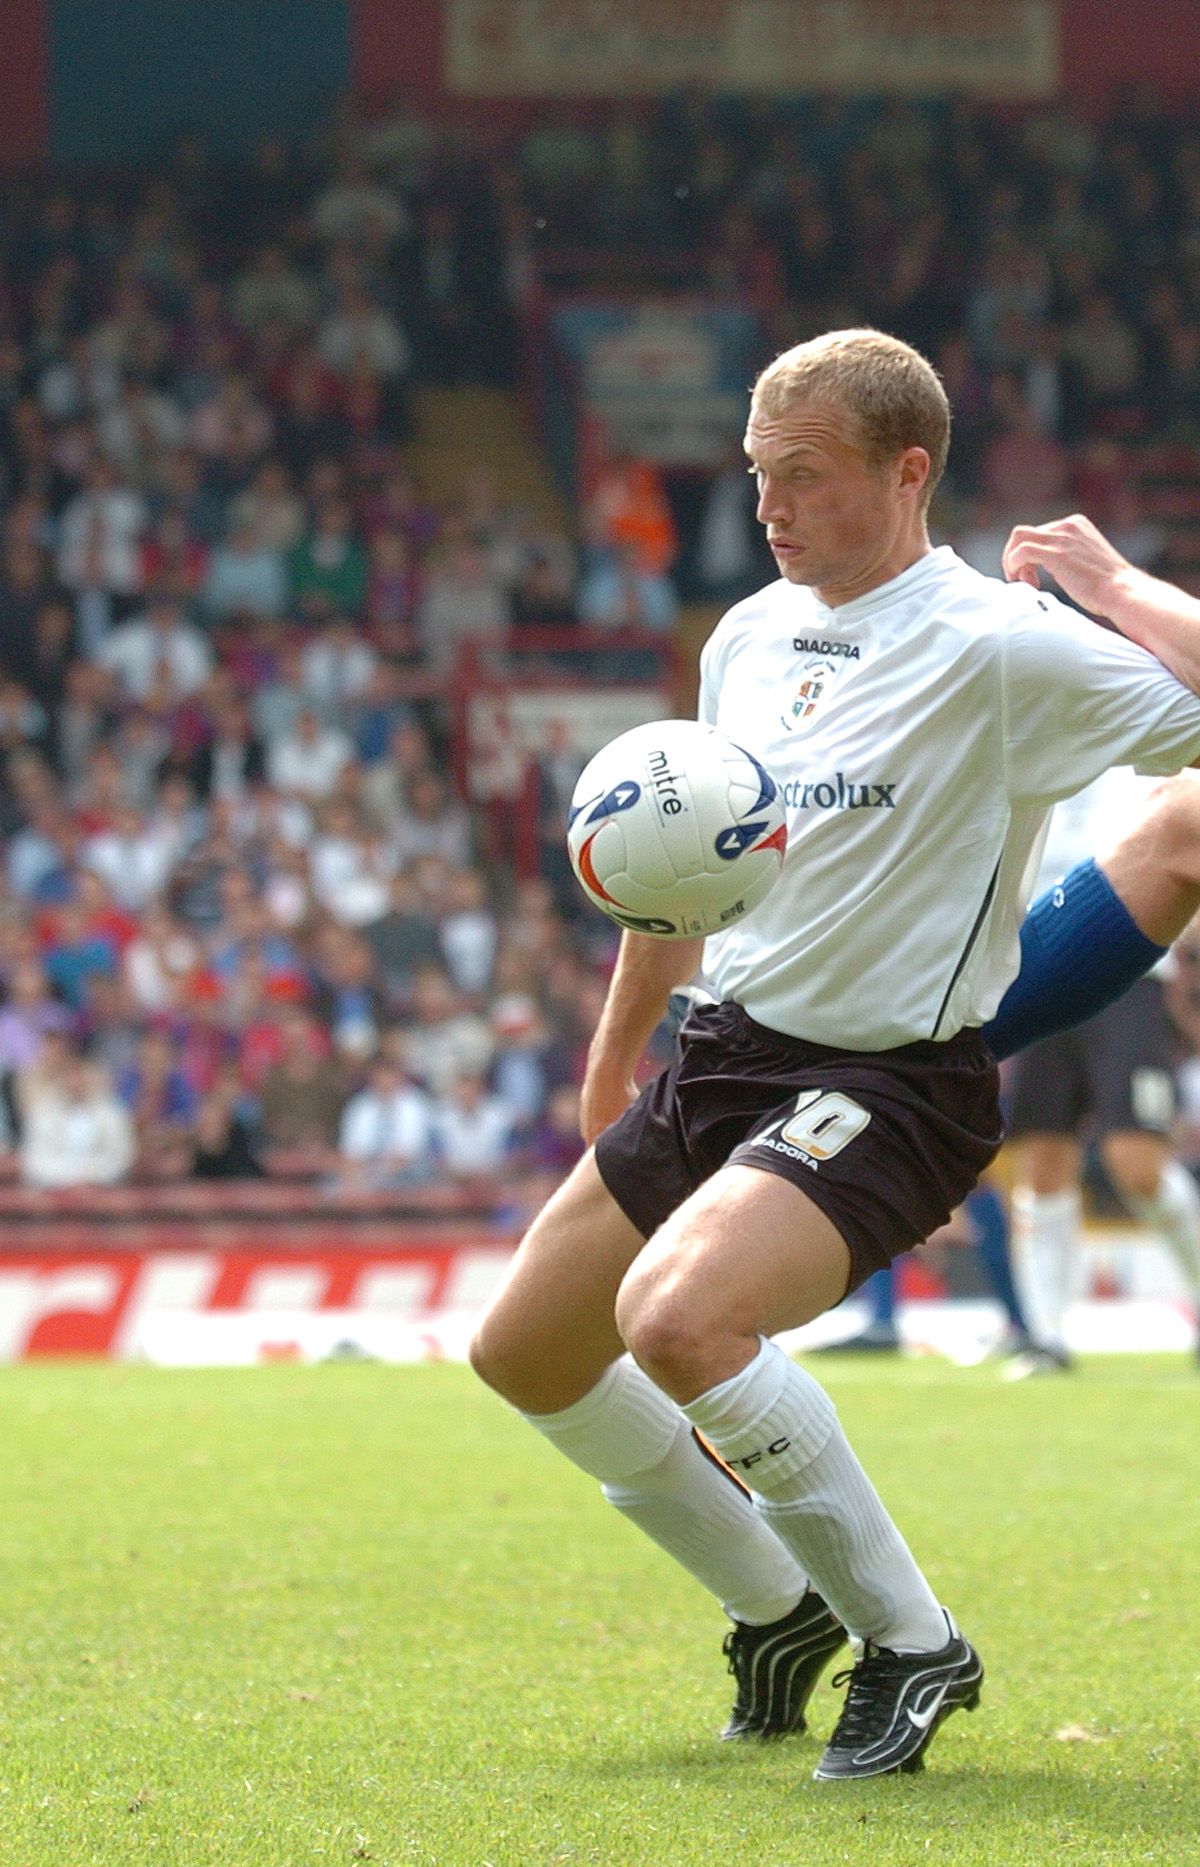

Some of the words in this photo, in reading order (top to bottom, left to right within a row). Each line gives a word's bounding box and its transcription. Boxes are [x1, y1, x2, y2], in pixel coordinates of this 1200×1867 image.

[793, 638, 861, 660] DIADORA
[647, 750, 683, 816] mitre
[777, 772, 897, 810] ctrolux
[753, 1135, 819, 1172] ADORA
